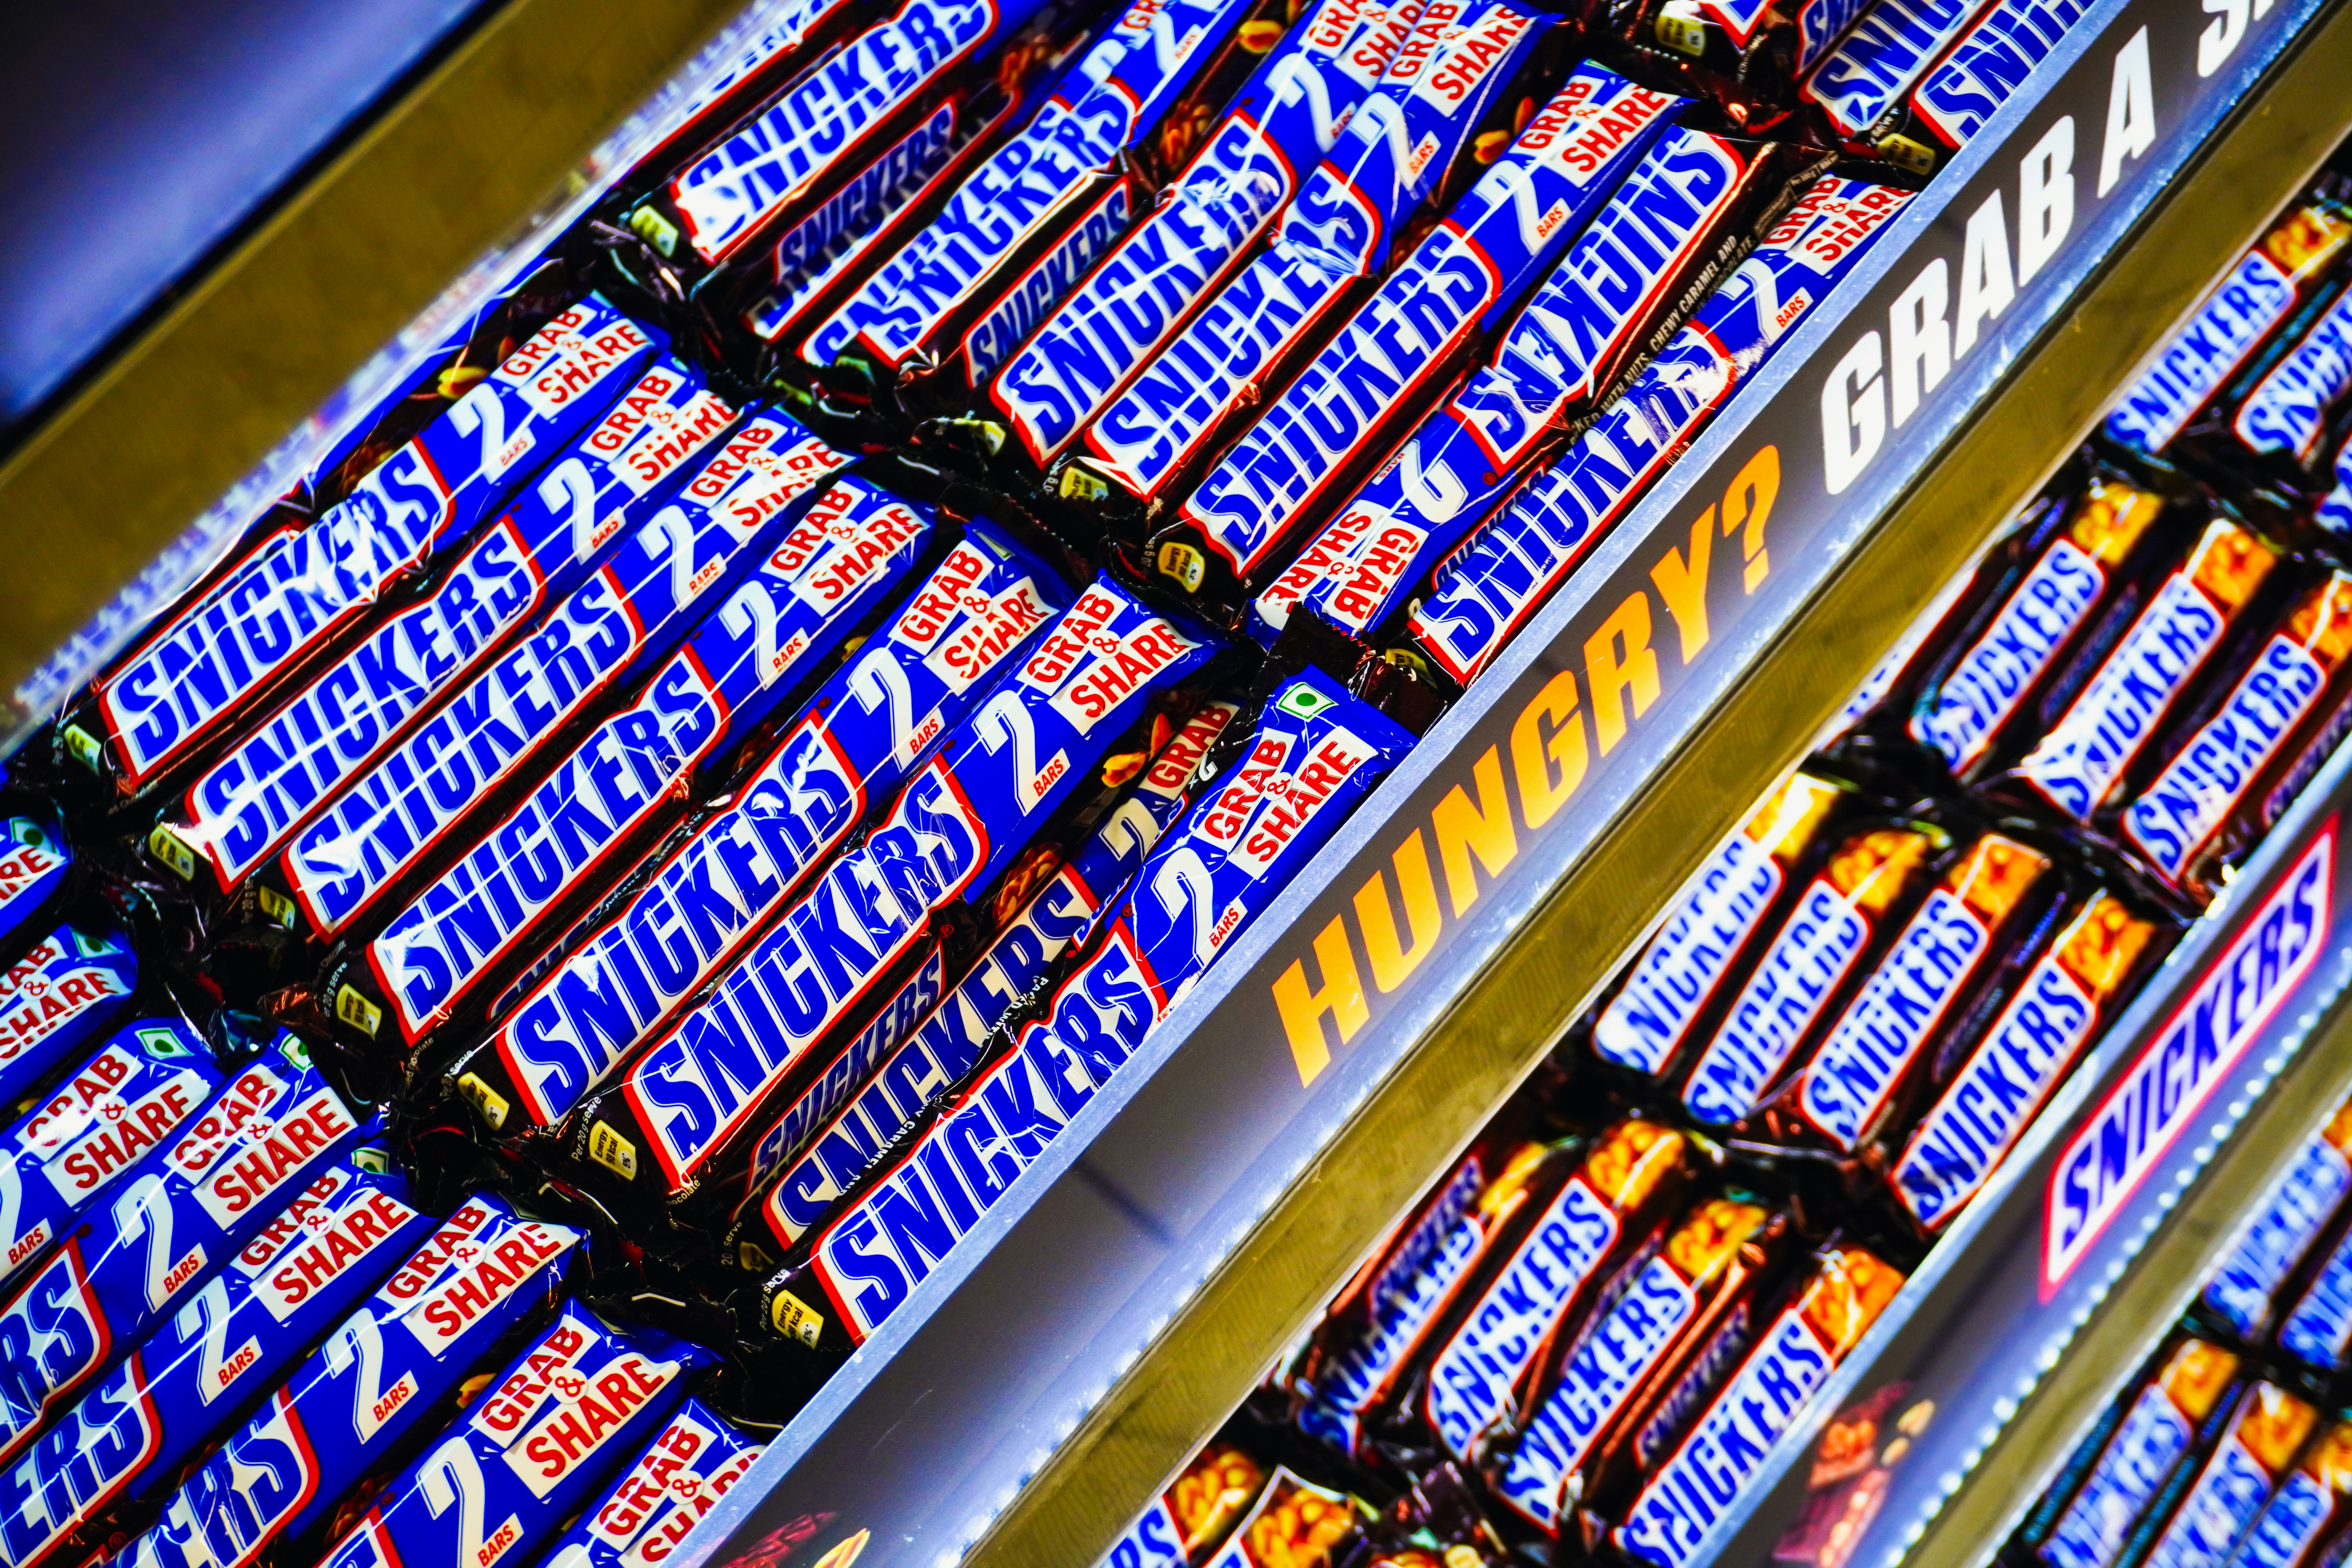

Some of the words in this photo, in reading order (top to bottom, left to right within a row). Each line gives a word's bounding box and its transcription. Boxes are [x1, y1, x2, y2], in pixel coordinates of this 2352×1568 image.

[1390, 3, 1458, 76] GRAB
[1431, 5, 1530, 100] SHARE
[1444, 26, 1466, 40] &
[1264, 53, 1333, 152] 2
[1346, 93, 1412, 191] 2
[1409, 141, 1434, 174] BARS
[1518, 81, 1592, 150] GRAB
[1562, 83, 1668, 172] SHARE
[1576, 104, 1602, 120] &
[1473, 160, 1542, 256] 2
[1536, 207, 1563, 238] BARS
[1763, 178, 1840, 244] GRAB
[1806, 186, 1913, 261] SHARE
[1823, 199, 1846, 213] &
[1680, 261, 1719, 314] CARAMEL
[1717, 235, 1737, 262] AND
[1717, 257, 1784, 344] 2
[1776, 295, 1806, 329] BARS
[502, 310, 582, 379] GRAB
[538, 324, 649, 403] SHARE
[562, 338, 581, 350] &
[447, 383, 505, 484] 2
[499, 437, 528, 467] BARS
[591, 374, 672, 451] GRAB
[650, 408, 672, 423] &
[1193, 231, 1488, 551] SNICKERS
[691, 426, 773, 497] GRAB
[751, 454, 775, 470] &
[1399, 438, 1469, 524] 2
[537, 457, 595, 565] 2
[771, 489, 852, 571] GRAB
[811, 507, 922, 600] SHARE
[831, 526, 854, 539] &
[637, 505, 695, 612] 2
[900, 549, 983, 642] GRAB
[1272, 445, 1781, 1089] HUNGRY?
[1821, 115, 2074, 495] GRAB
[2098, 24, 2156, 199] A
[1325, 557, 1354, 576] &
[1335, 526, 1419, 621] GRAB
[718, 580, 777, 691] 2
[773, 638, 802, 673] BARS
[944, 587, 1047, 679] SHARE
[962, 595, 990, 614] &
[1027, 593, 1114, 684] GRAB
[1093, 637, 1118, 653] &
[203, 524, 532, 867] SNICKERS
[846, 647, 913, 773] 2
[910, 720, 939, 754] BARS
[1070, 622, 1189, 719] SHARE
[297, 575, 615, 922] SNICKERS
[971, 690, 1038, 817] 2
[1033, 759, 1064, 797] BARS
[1148, 706, 1231, 788] GRAB
[1204, 740, 1286, 840] GRAB
[1267, 777, 1288, 795] &
[384, 659, 716, 1019] SNICKERS
[1247, 741, 1361, 862] SHARE
[513, 729, 854, 1118] SNICKERS
[1151, 848, 1212, 968] 2
[1210, 908, 1239, 947] BARS
[24, 980, 49, 996] &
[330, 962, 347, 988] serve
[639, 767, 976, 1161] SNICKERS
[756, 960, 941, 1172] SNICKERS
[1899, 969, 2086, 1221] SNICKERS
[2063, 857, 2320, 1254] SNICKERS
[64, 1084, 190, 1189] SHARE
[101, 1103, 123, 1121] &
[174, 1073, 277, 1170] GRAB
[249, 1122, 272, 1140] &
[572, 1143, 583, 1161] Per
[577, 1130, 586, 1145] 20
[582, 1123, 589, 1133] g
[583, 1096, 602, 1124] serve
[595, 1129, 608, 1158] Energy
[610, 1137, 619, 1156] kcal
[830, 941, 1160, 1329] SNICKERS
[214, 1099, 349, 1211] SHARE
[606, 1151, 615, 1165] 98
[9, 1228, 45, 1265] BARS
[111, 1174, 173, 1314] 2
[164, 1255, 200, 1294] BARS
[241, 1174, 338, 1266] GRAB
[274, 1192, 408, 1303] SHARE
[307, 1216, 327, 1232] &
[387, 1205, 486, 1298] GRAB
[456, 1247, 479, 1263] &
[724, 1221, 742, 1247] serve
[425, 1224, 561, 1337] SHARE
[759, 1312, 768, 1331] Per
[761, 1303, 769, 1317] 20
[762, 1293, 771, 1304] g
[763, 1269, 790, 1294] serve
[778, 1298, 793, 1329] Energy
[791, 1307, 804, 1328] kcal
[176, 1276, 230, 1406] 2
[218, 1347, 254, 1386] BARS
[322, 1307, 383, 1444] 2
[373, 1380, 409, 1422] BARS
[481, 1327, 583, 1432] GRAB
[526, 1359, 664, 1478] SHARE
[554, 1376, 582, 1397] &
[415, 1436, 485, 1568] 2
[477, 1525, 514, 1567] BARS
[599, 1425, 700, 1536] GRAB
[671, 1476, 699, 1498] &
